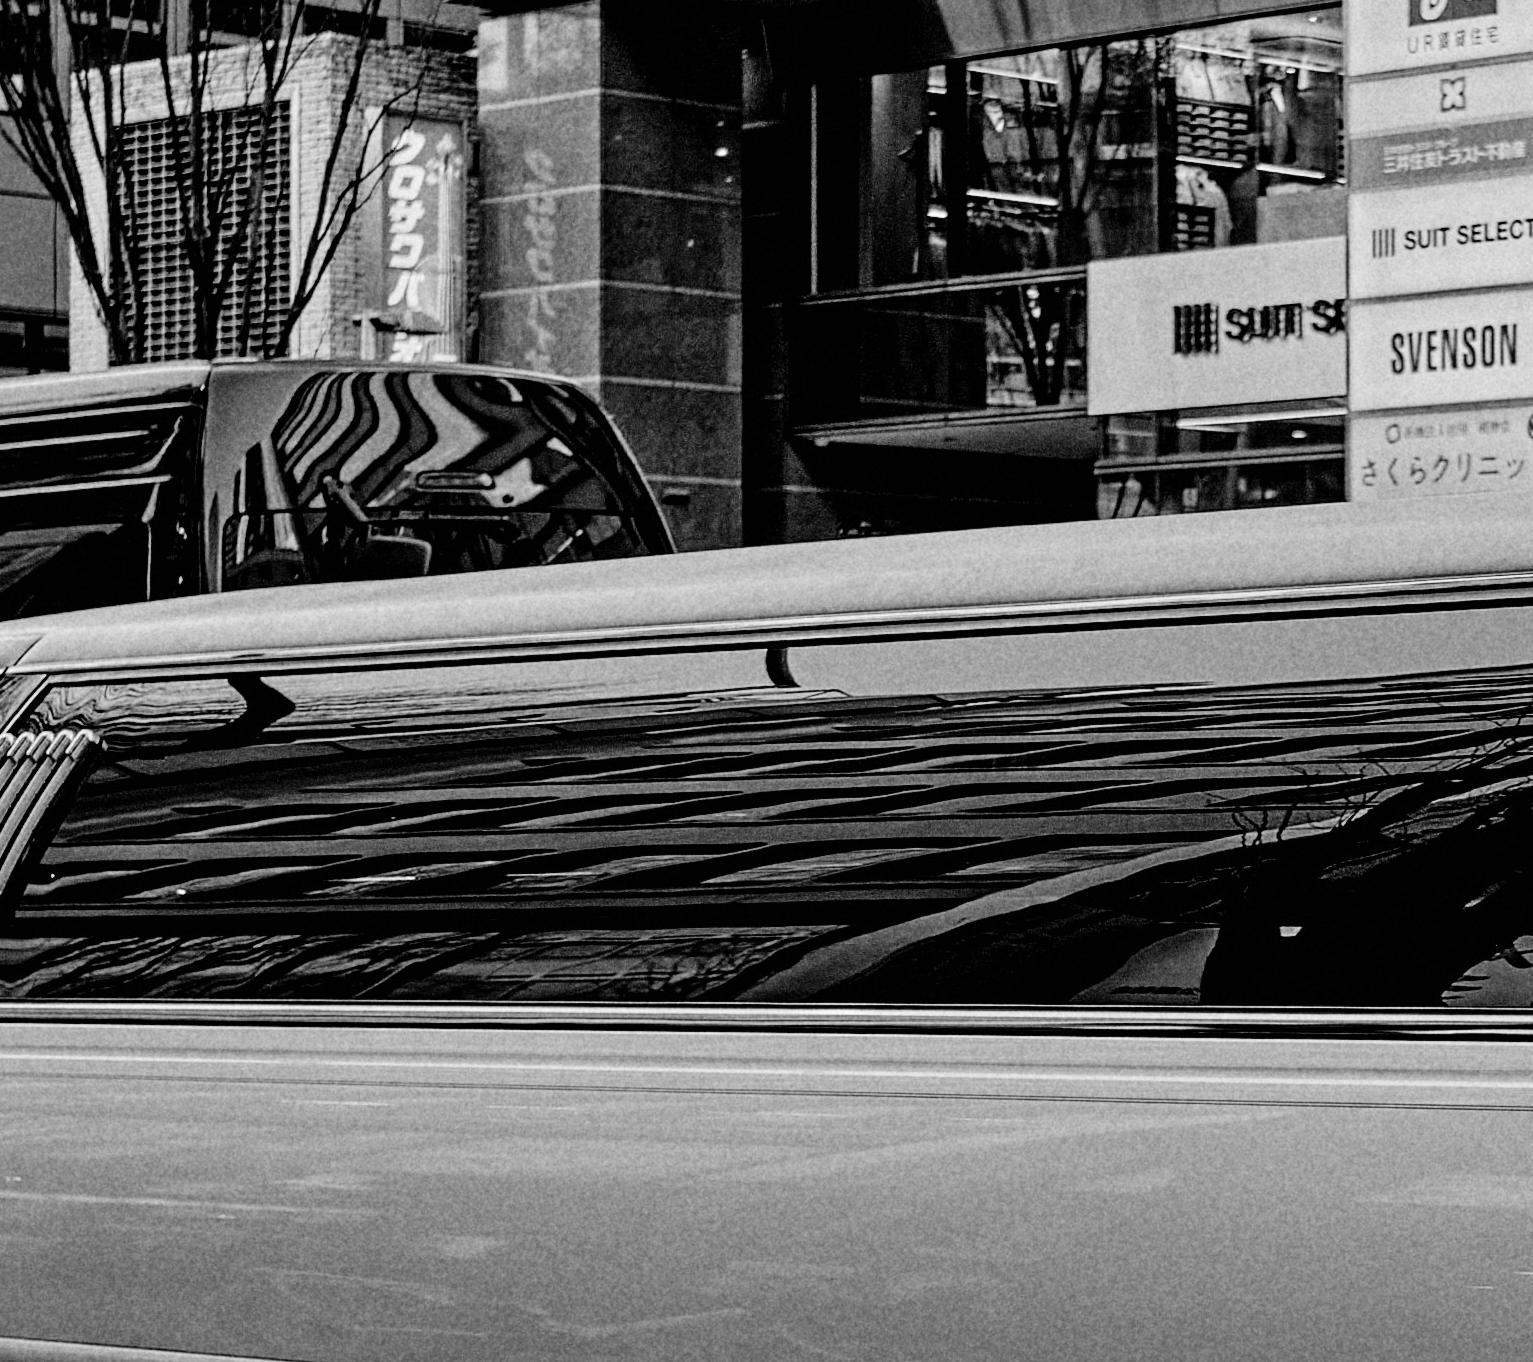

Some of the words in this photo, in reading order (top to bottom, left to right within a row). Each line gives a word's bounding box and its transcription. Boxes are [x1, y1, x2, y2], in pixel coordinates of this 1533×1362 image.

[1403, 228, 1450, 250] SUIT
[1225, 304, 1302, 343] SUIT
[1390, 322, 1518, 375] SVENSON
